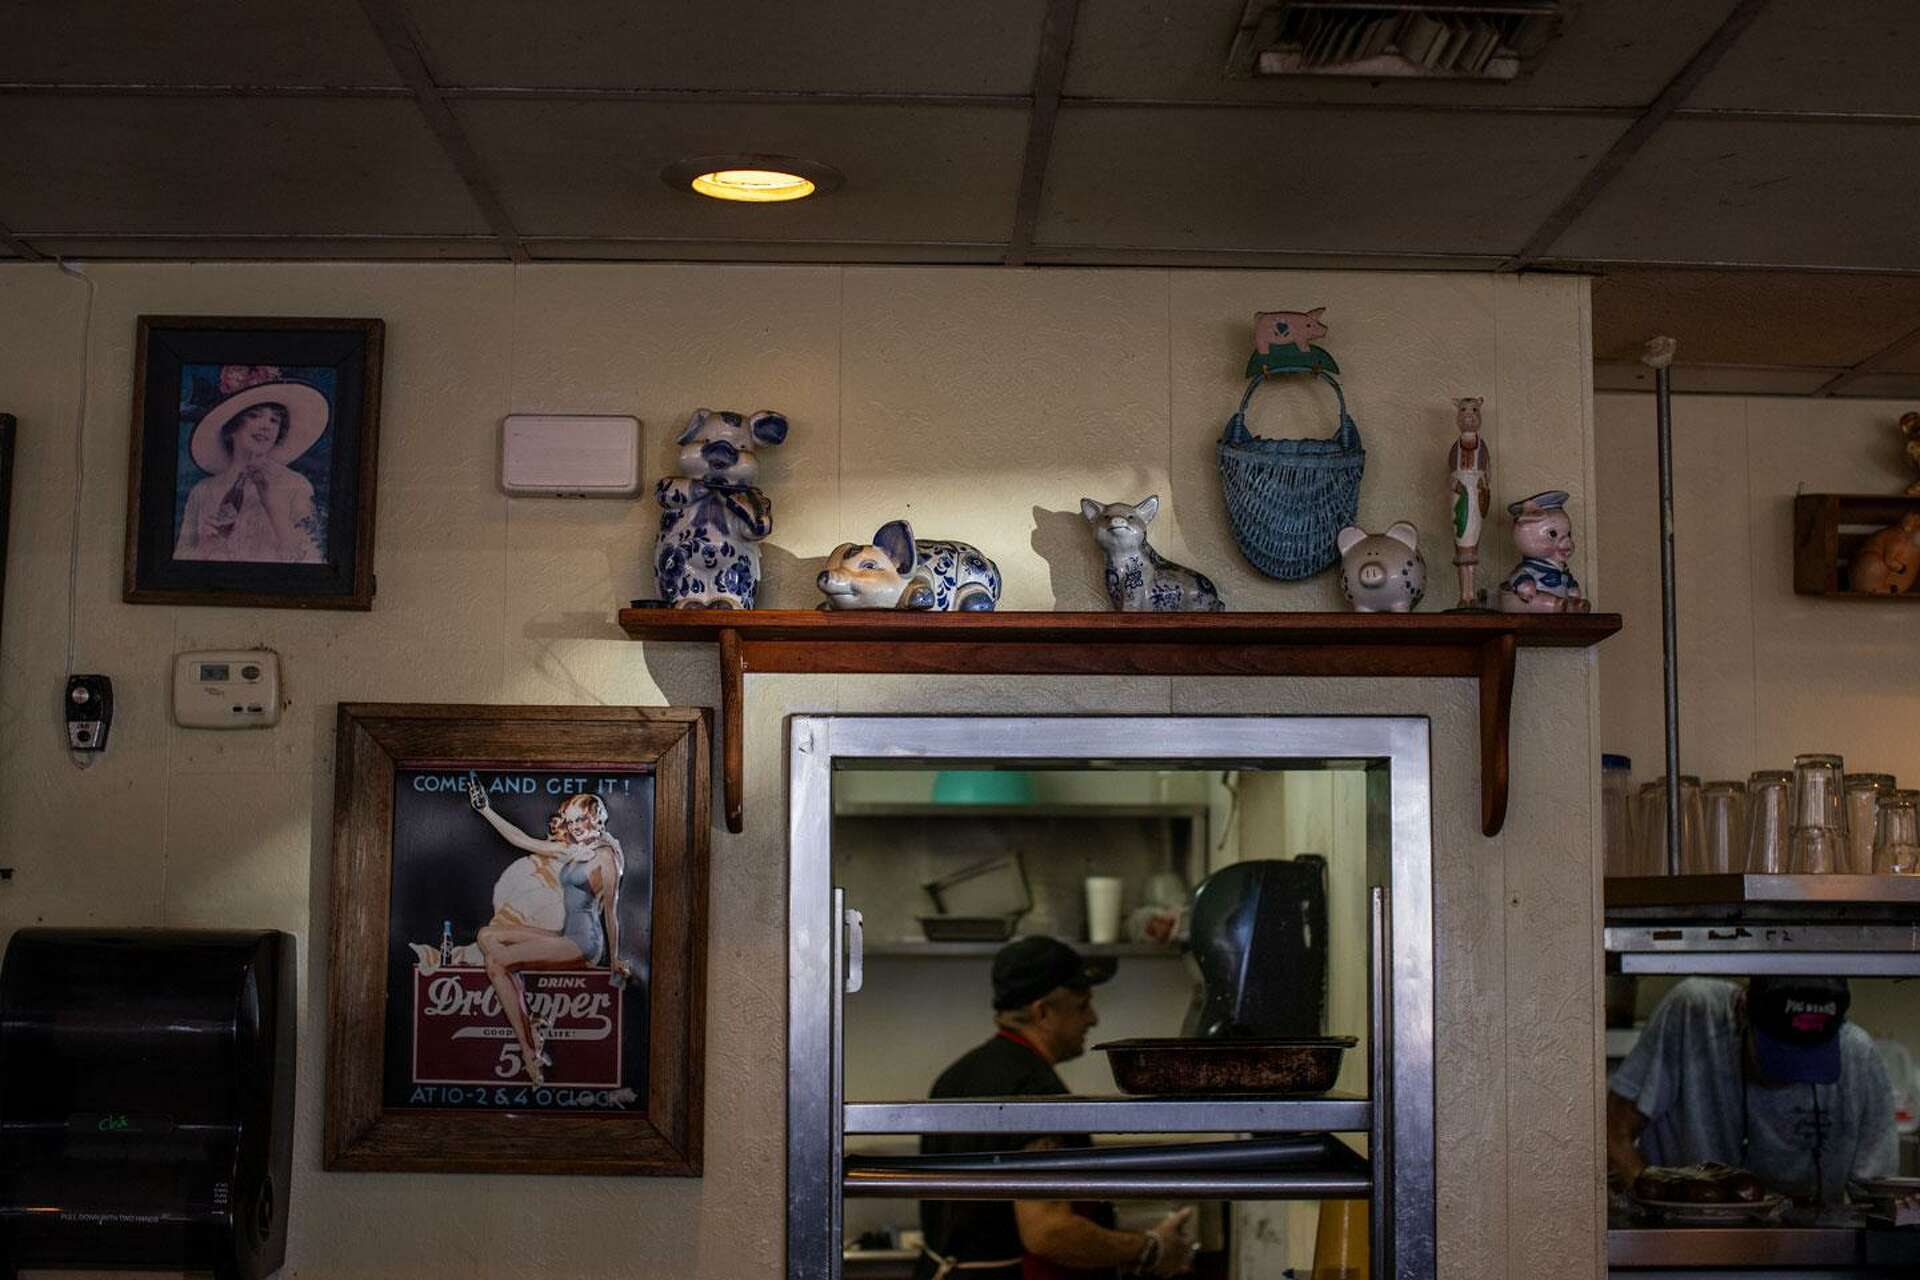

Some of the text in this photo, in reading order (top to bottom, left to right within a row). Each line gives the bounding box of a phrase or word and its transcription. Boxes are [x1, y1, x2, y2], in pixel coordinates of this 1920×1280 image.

[413, 775, 467, 792] COME
[490, 776, 536, 793] AND
[546, 778, 586, 794] GET
[538, 977, 587, 989] DRINK
[409, 1087, 437, 1104] AT
[494, 1087, 509, 1105] &
[514, 1087, 528, 1105] 4
